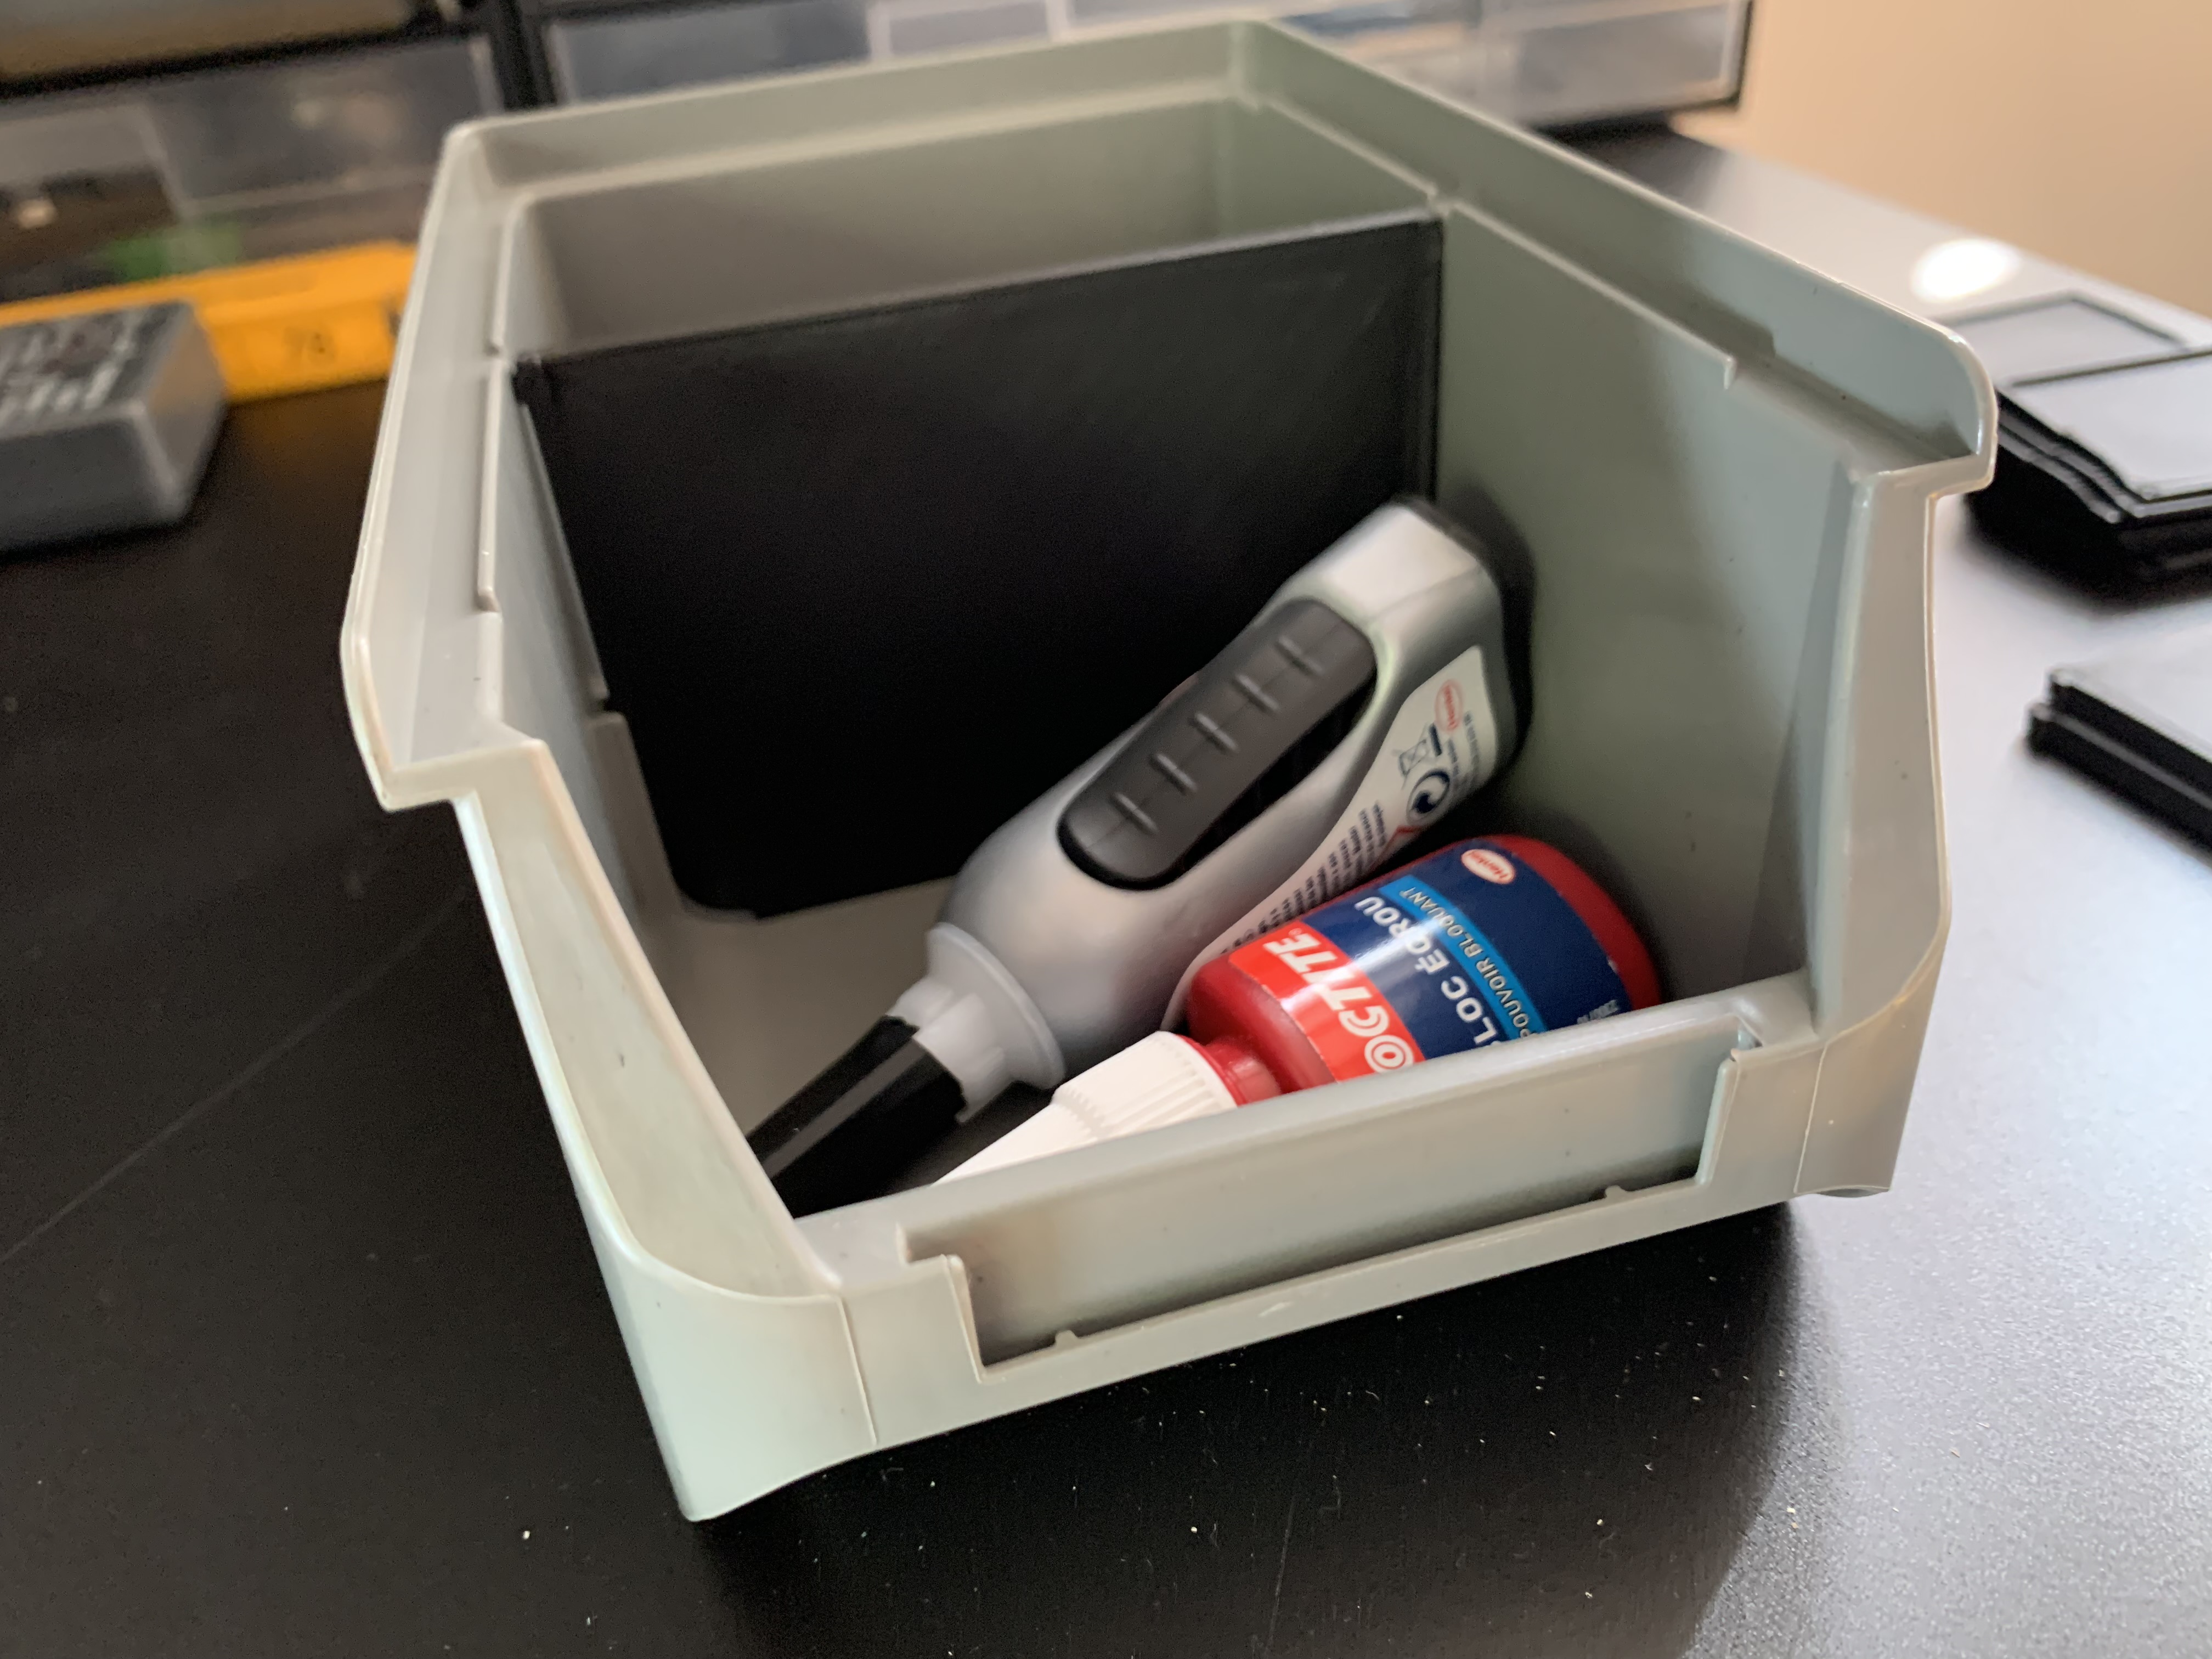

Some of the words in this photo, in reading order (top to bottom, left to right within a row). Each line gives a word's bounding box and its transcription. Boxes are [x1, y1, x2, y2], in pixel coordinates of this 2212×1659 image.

[1400, 887, 1485, 958] BLOQUANT
[1262, 932, 1414, 1073] OCTITE
[1441, 975, 1502, 1045] LOC
